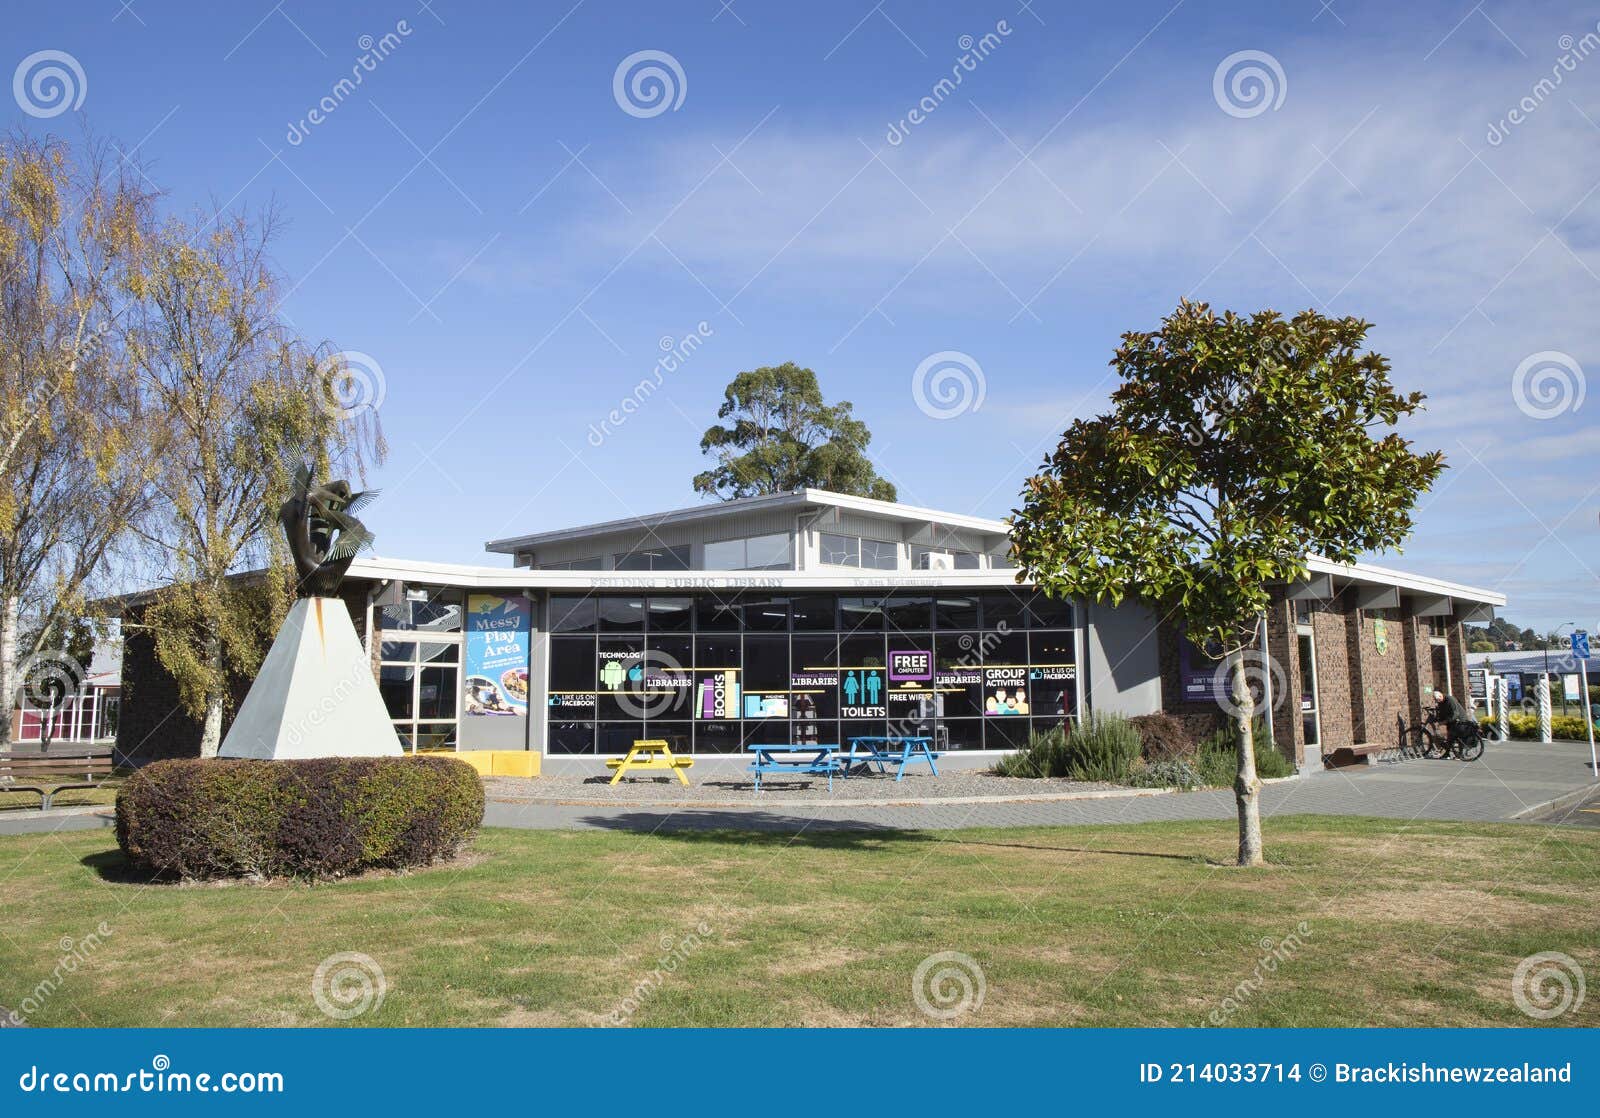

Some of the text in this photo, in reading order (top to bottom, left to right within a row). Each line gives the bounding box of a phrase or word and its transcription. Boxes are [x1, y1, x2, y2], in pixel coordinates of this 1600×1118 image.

[665, 577, 716, 588] PUBLIC
[725, 577, 784, 588] LIBRARY
[475, 615, 521, 632] Messy
[484, 631, 516, 644] Play
[484, 643, 521, 658] Area
[894, 655, 928, 668] FREE
[936, 675, 981, 684] LIBRARIES
[986, 669, 1026, 679] GROUP
[647, 679, 693, 687] LIBRARIES
[791, 677, 838, 686] LIBRARIES
[986, 679, 1026, 687] ACTIVITIES
[714, 673, 725, 717] BOOKS
[889, 693, 908, 701] FREE
[841, 707, 886, 718] TOILETS
